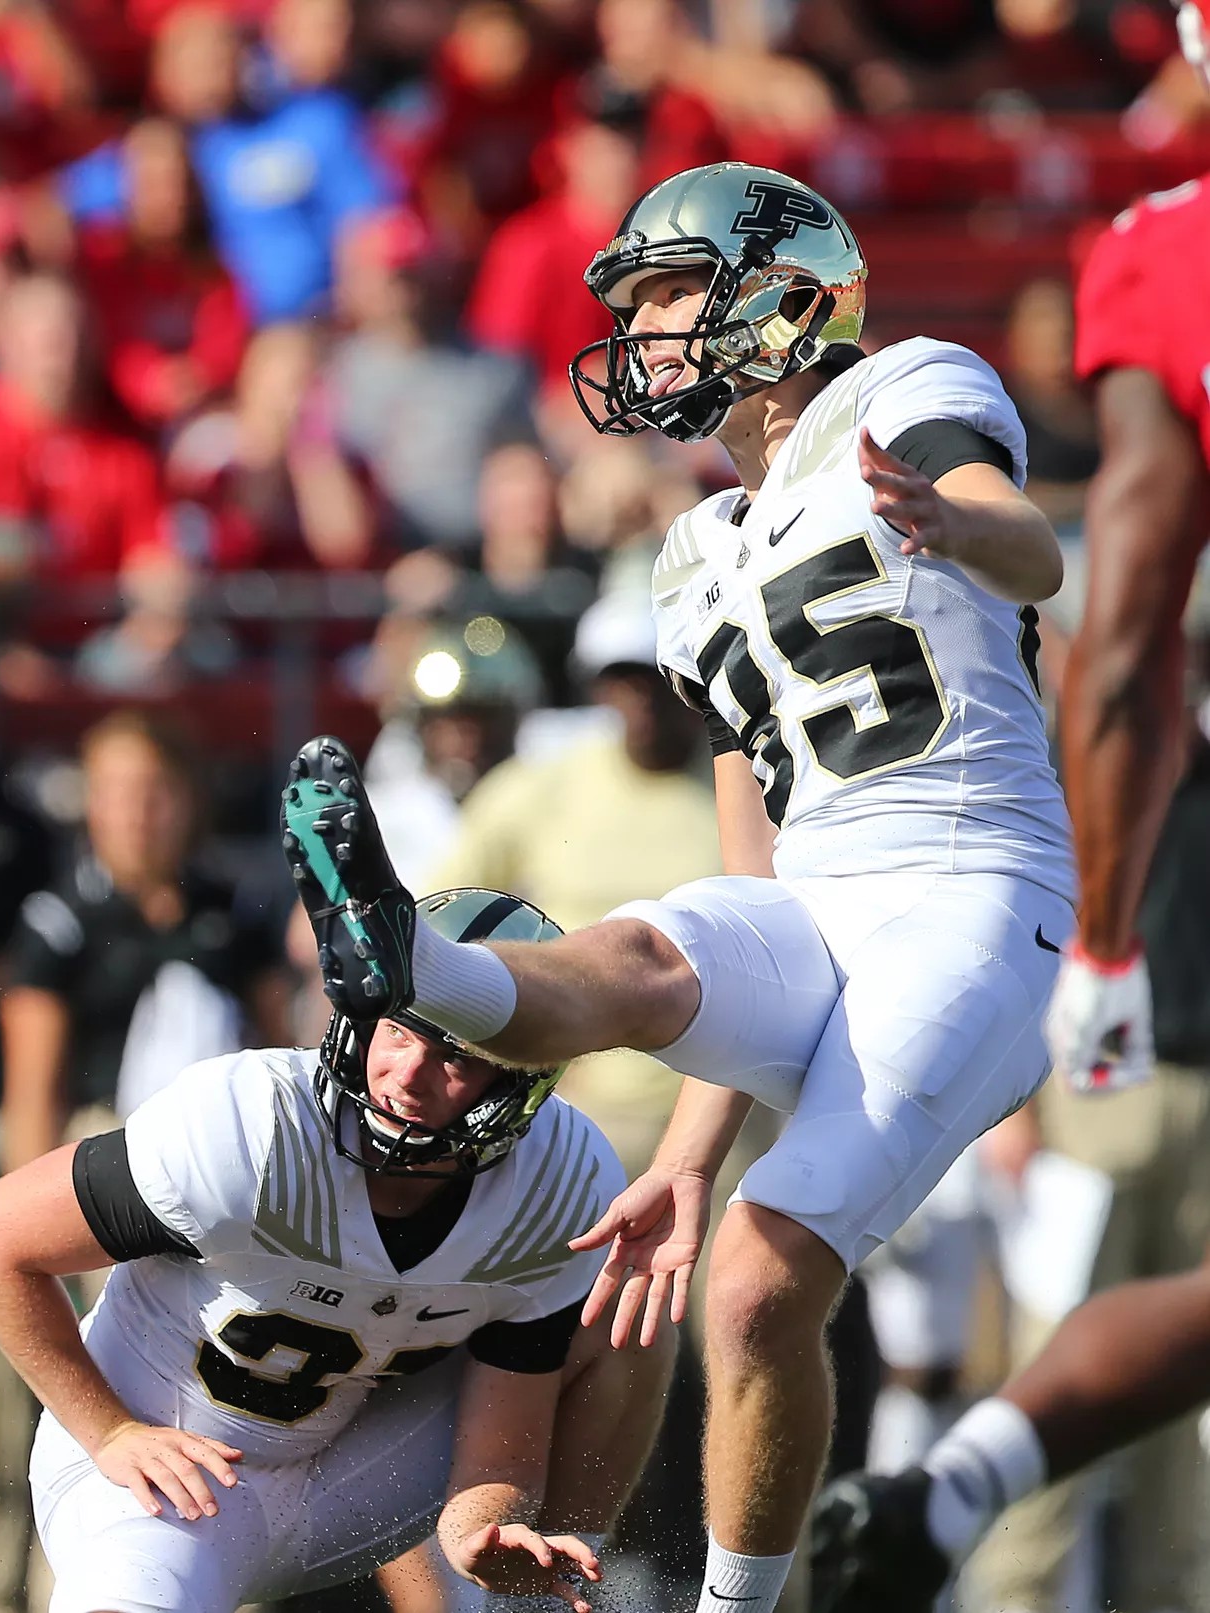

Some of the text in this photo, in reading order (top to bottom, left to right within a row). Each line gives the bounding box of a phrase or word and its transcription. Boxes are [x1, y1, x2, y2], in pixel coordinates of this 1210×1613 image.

[730, 180, 834, 240] P
[465, 1100, 501, 1127] Ridd
[372, 1139, 390, 1155] Ridd
